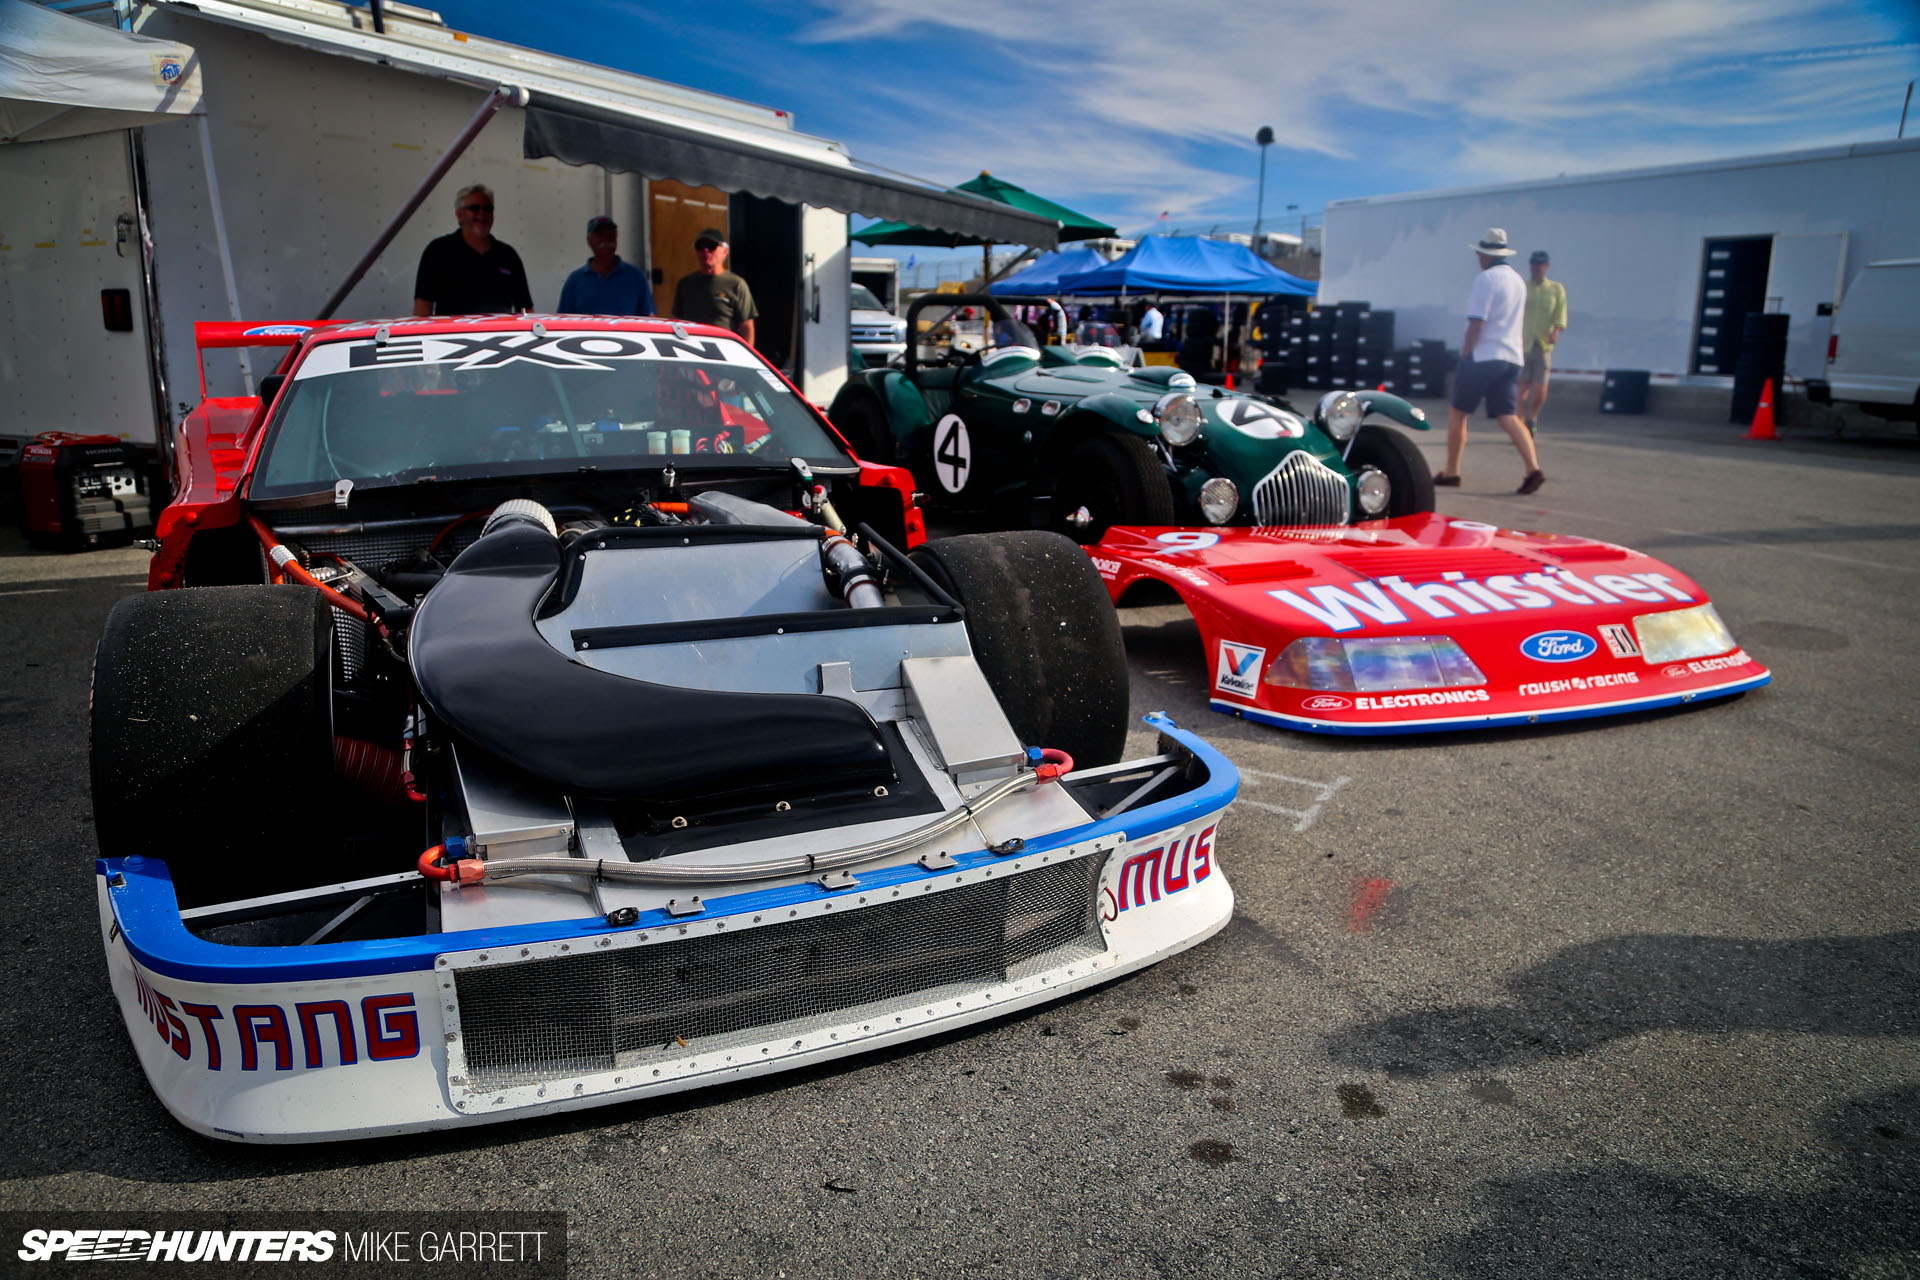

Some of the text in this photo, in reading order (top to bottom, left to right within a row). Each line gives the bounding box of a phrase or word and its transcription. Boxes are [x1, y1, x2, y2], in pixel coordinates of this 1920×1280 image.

[349, 335, 727, 369] EXXON
[938, 420, 967, 489] 4
[1155, 531, 1221, 555] 9
[1267, 567, 1694, 633] Whistler
[1538, 636, 1584, 656] Ford
[1221, 673, 1254, 691] Valvoline
[1355, 689, 1490, 710] ELECTRONICS
[1118, 820, 1220, 913] MUS
[128, 954, 421, 1072] MUSTANG
